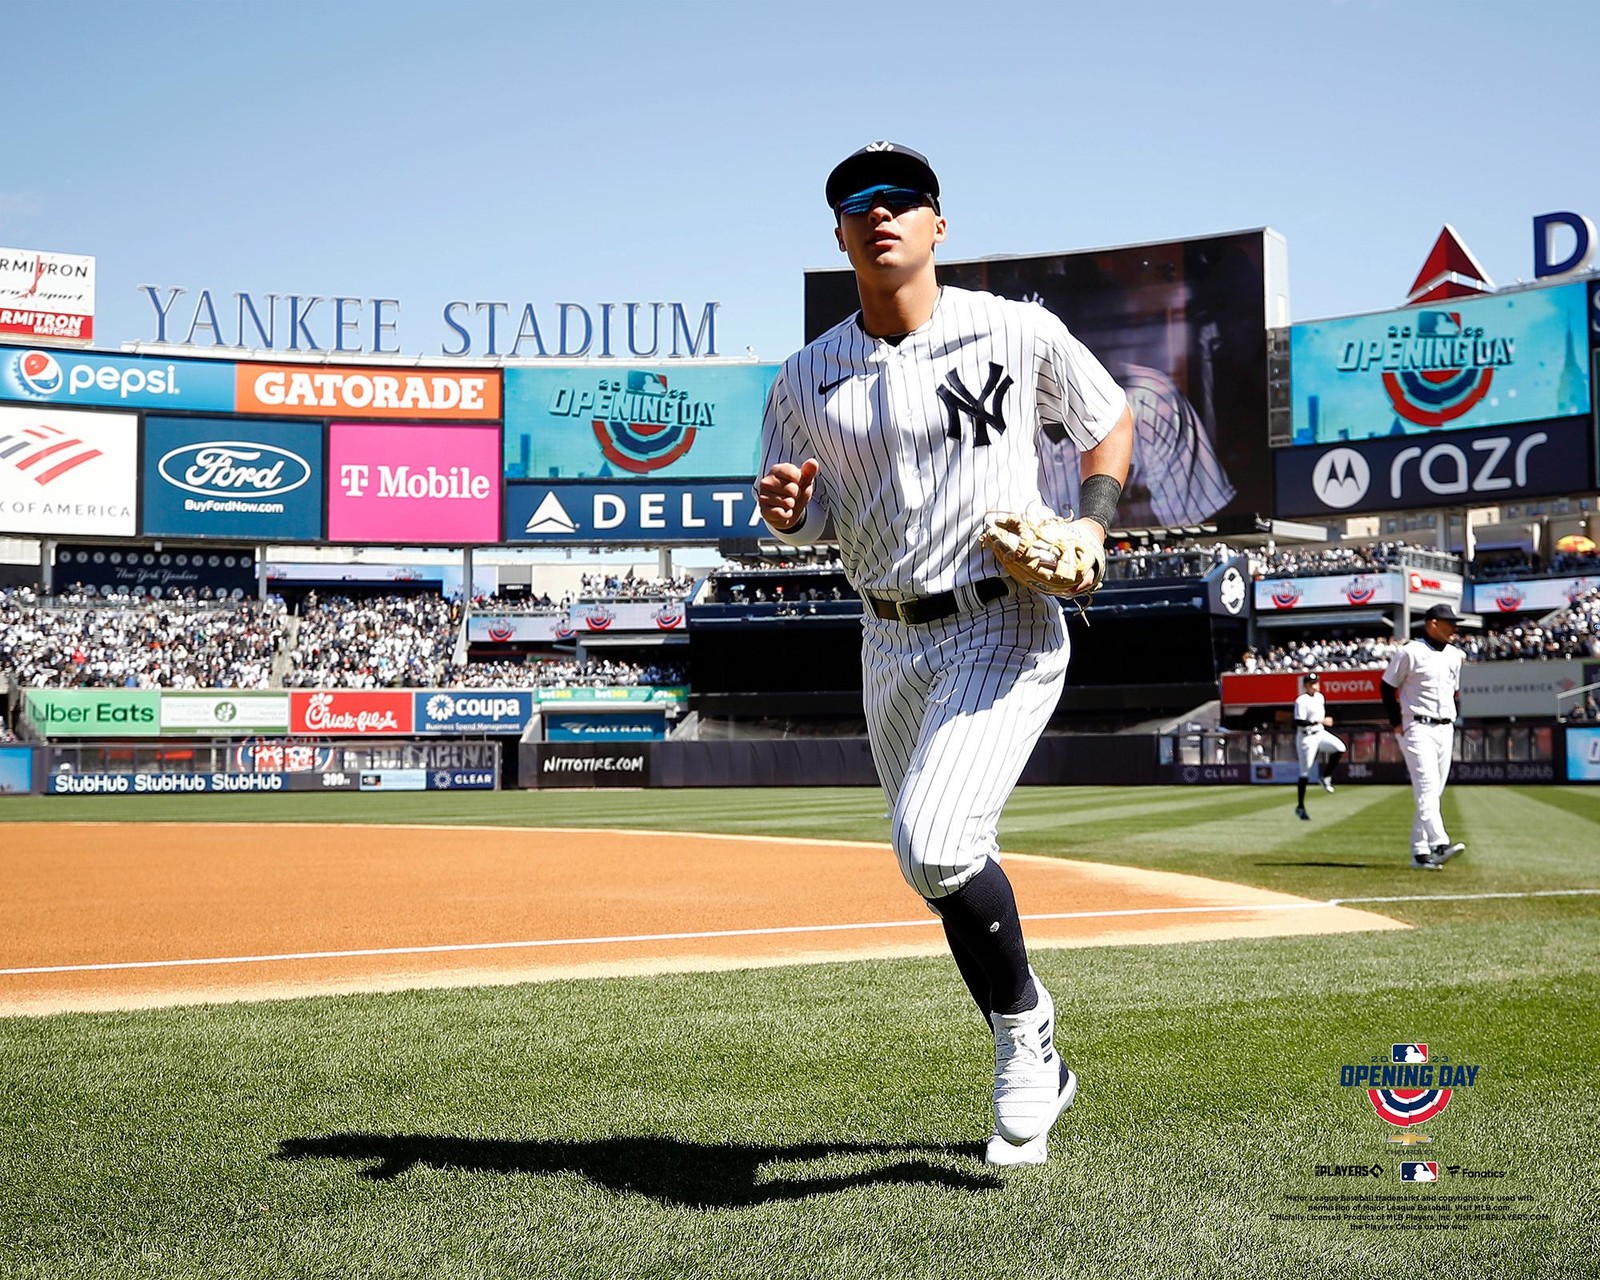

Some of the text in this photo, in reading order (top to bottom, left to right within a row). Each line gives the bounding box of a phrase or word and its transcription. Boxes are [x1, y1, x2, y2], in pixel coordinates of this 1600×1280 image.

[137, 284, 722, 359] YANKEE STADIUM
[1336, 337, 1470, 372] OPENING
[69, 365, 176, 398] pepsi
[254, 372, 484, 410] GATORADE
[548, 384, 716, 427] OPENING DAY
[185, 448, 285, 489] Ford
[1390, 432, 1547, 498] razr
[377, 466, 490, 499] Mobile
[13, 501, 36, 515] OF
[42, 503, 131, 518] AMERICA
[185, 499, 284, 514] BuyFordNow.com
[1325, 680, 1375, 694] TOYOTA
[1463, 682, 1553, 694] BANK OF AMERICA
[96, 703, 154, 723] Eats
[456, 698, 520, 720] coupa
[455, 723, 476, 733] Spend
[543, 756, 643, 772] NITTOTIRE.COM
[1204, 767, 1239, 779] CLEAR
[55, 774, 128, 793] StubHub
[134, 774, 206, 792] StubHub
[211, 773, 282, 792] StubHub
[454, 774, 492, 785] CLEAR
